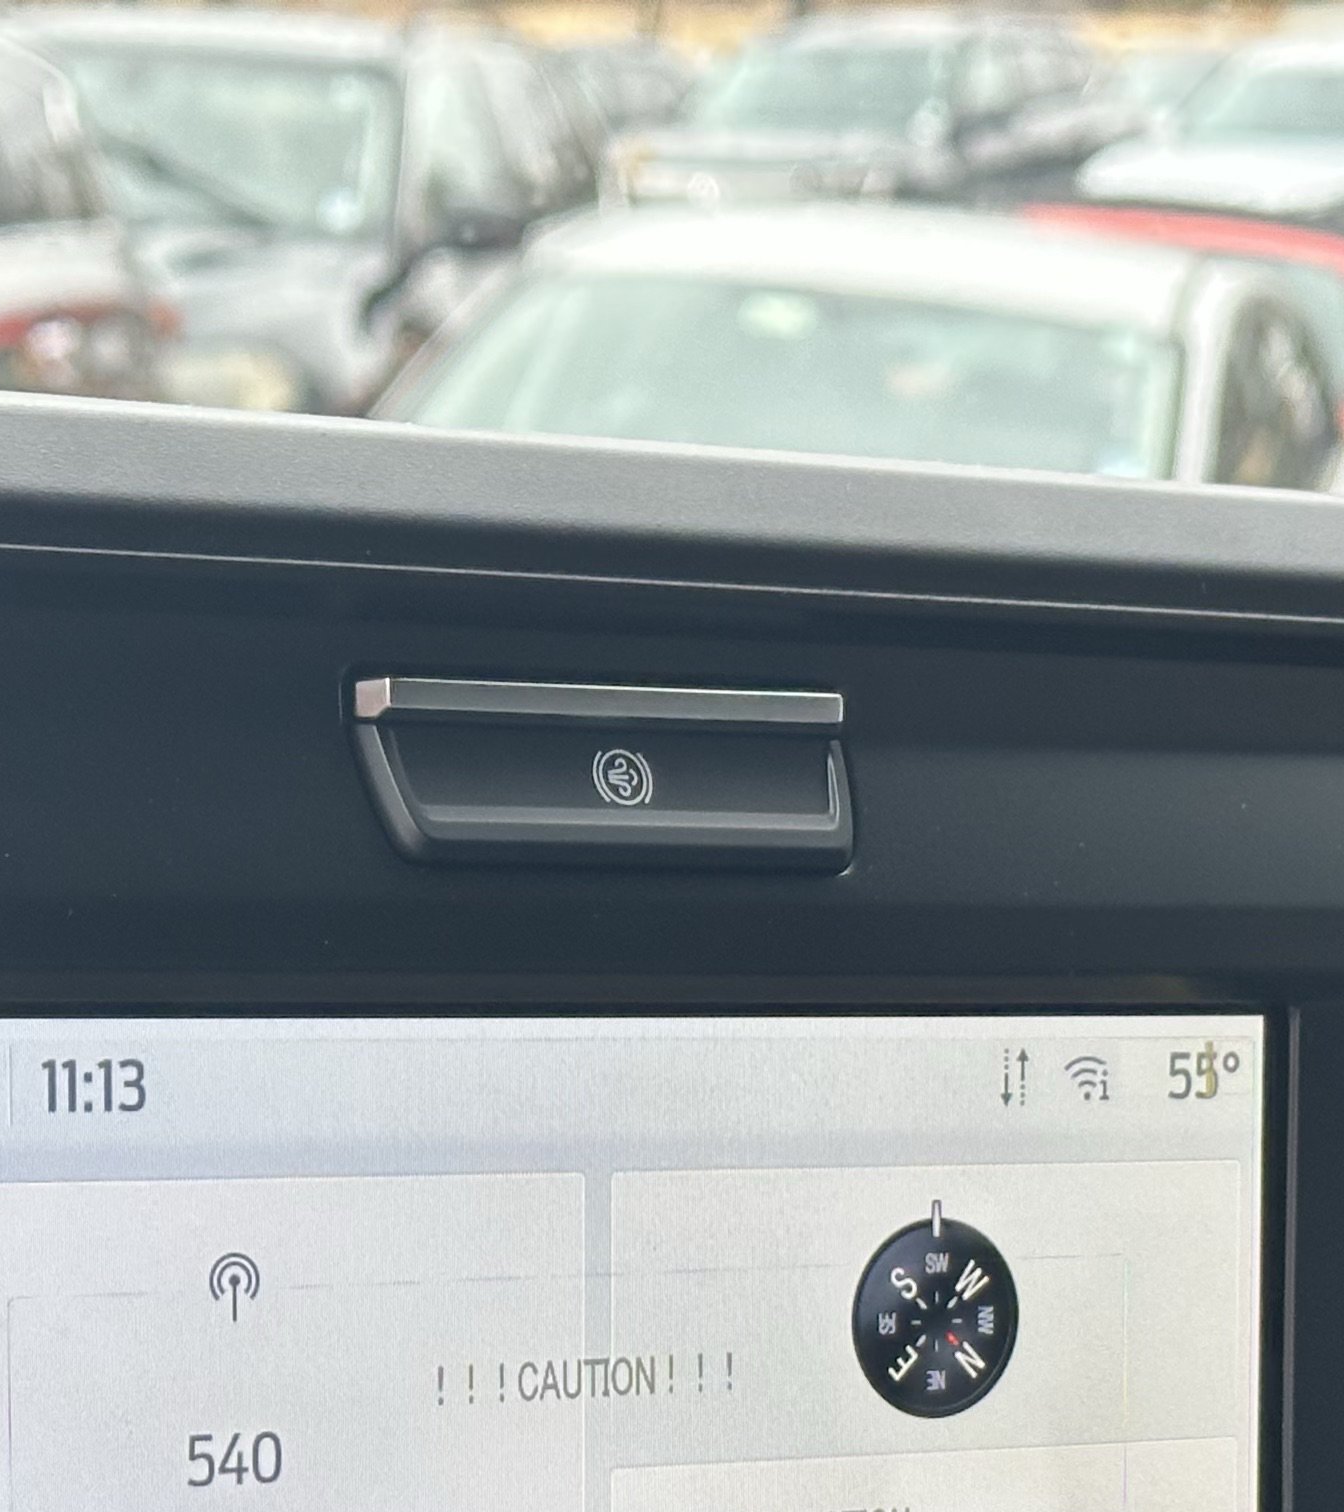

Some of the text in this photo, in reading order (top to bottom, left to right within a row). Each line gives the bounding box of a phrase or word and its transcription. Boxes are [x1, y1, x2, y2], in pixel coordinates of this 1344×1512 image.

[41, 1058, 147, 1113] 11:13
[924, 1252, 950, 1275] SW
[954, 1259, 991, 1301] W
[890, 1266, 918, 1300] S
[878, 1311, 897, 1336] SE
[976, 1304, 995, 1336] NW
[887, 1344, 919, 1382] E
[954, 1340, 986, 1379] N
[925, 1369, 947, 1391] NE
[187, 1431, 282, 1487] 540
